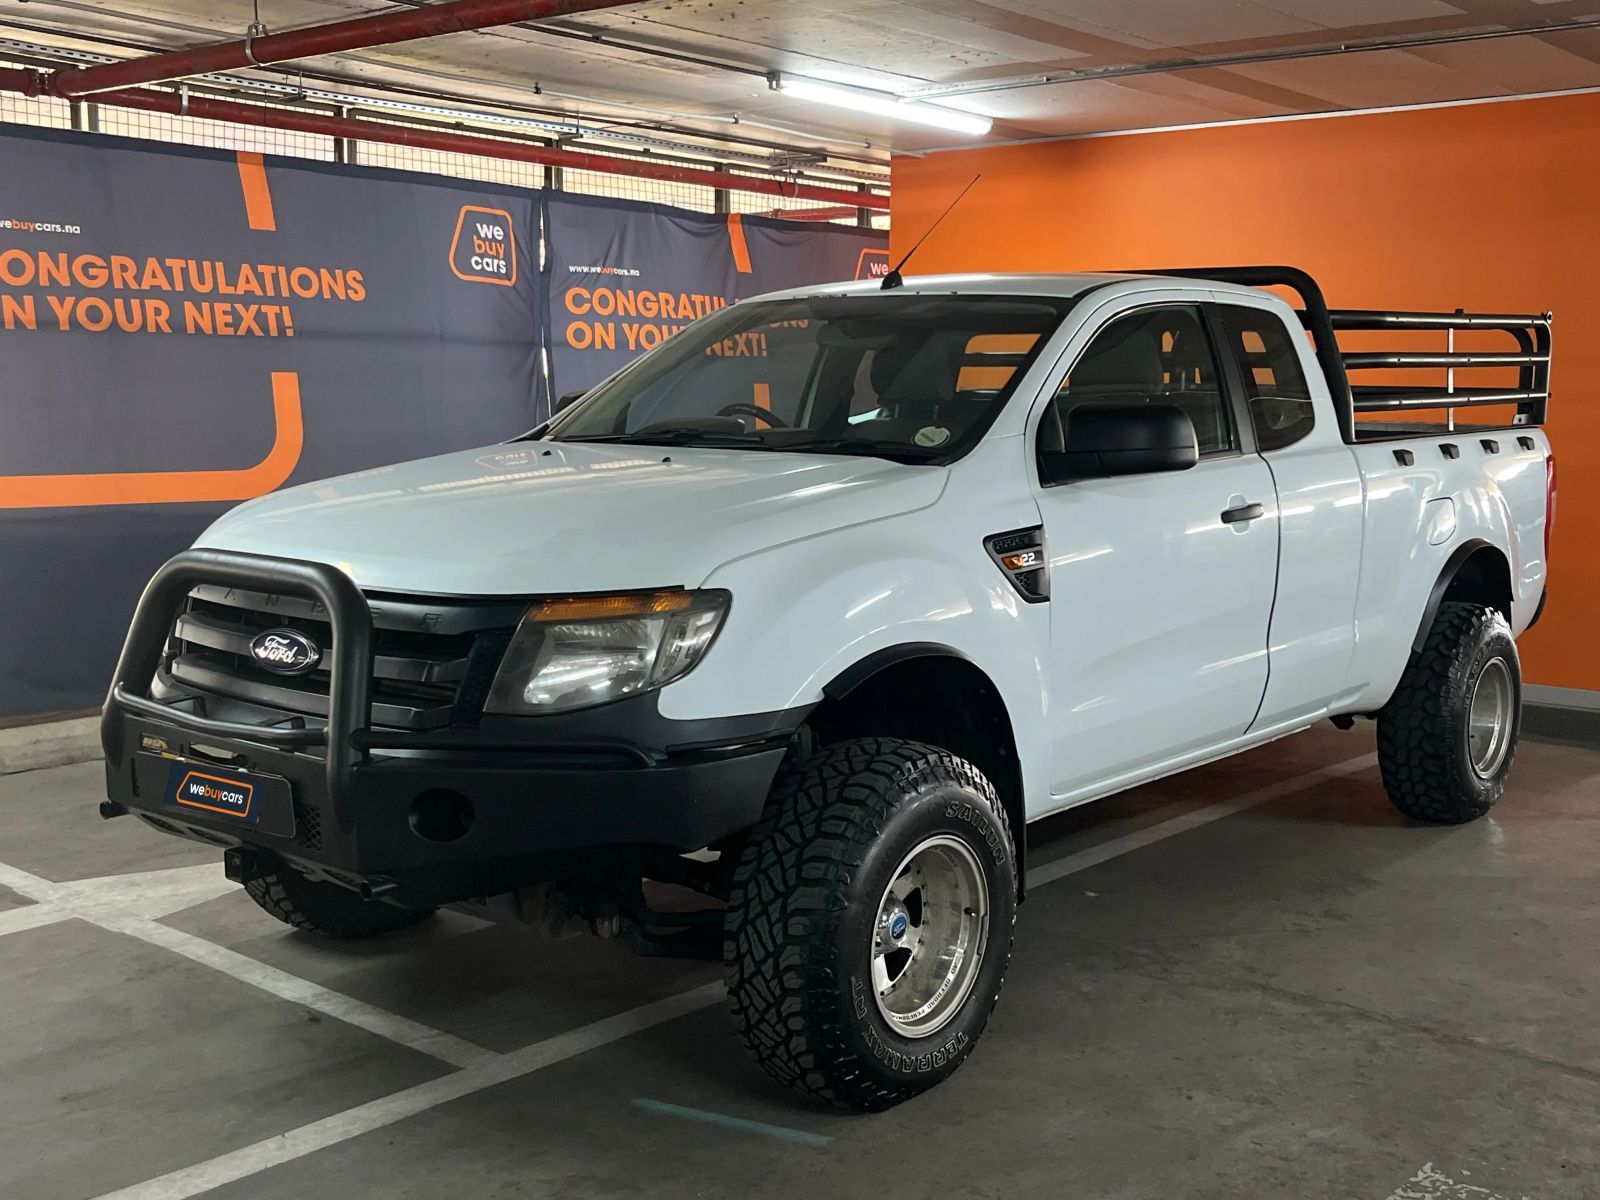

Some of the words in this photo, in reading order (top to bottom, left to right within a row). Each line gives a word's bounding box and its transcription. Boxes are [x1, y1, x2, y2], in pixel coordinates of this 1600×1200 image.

[476, 223, 504, 240] we
[473, 235, 504, 259] buy
[0, 248, 366, 301] ONGRATULATIONS
[471, 256, 506, 273] cars
[870, 262, 889, 275] we
[1, 294, 37, 330] N
[46, 295, 172, 333] YOUR
[184, 301, 294, 337] NEXT!
[566, 320, 616, 350] ON
[255, 635, 298, 665] Ford
[945, 800, 1006, 866] SAILUN
[861, 1023, 969, 1073] TERRAMAX
